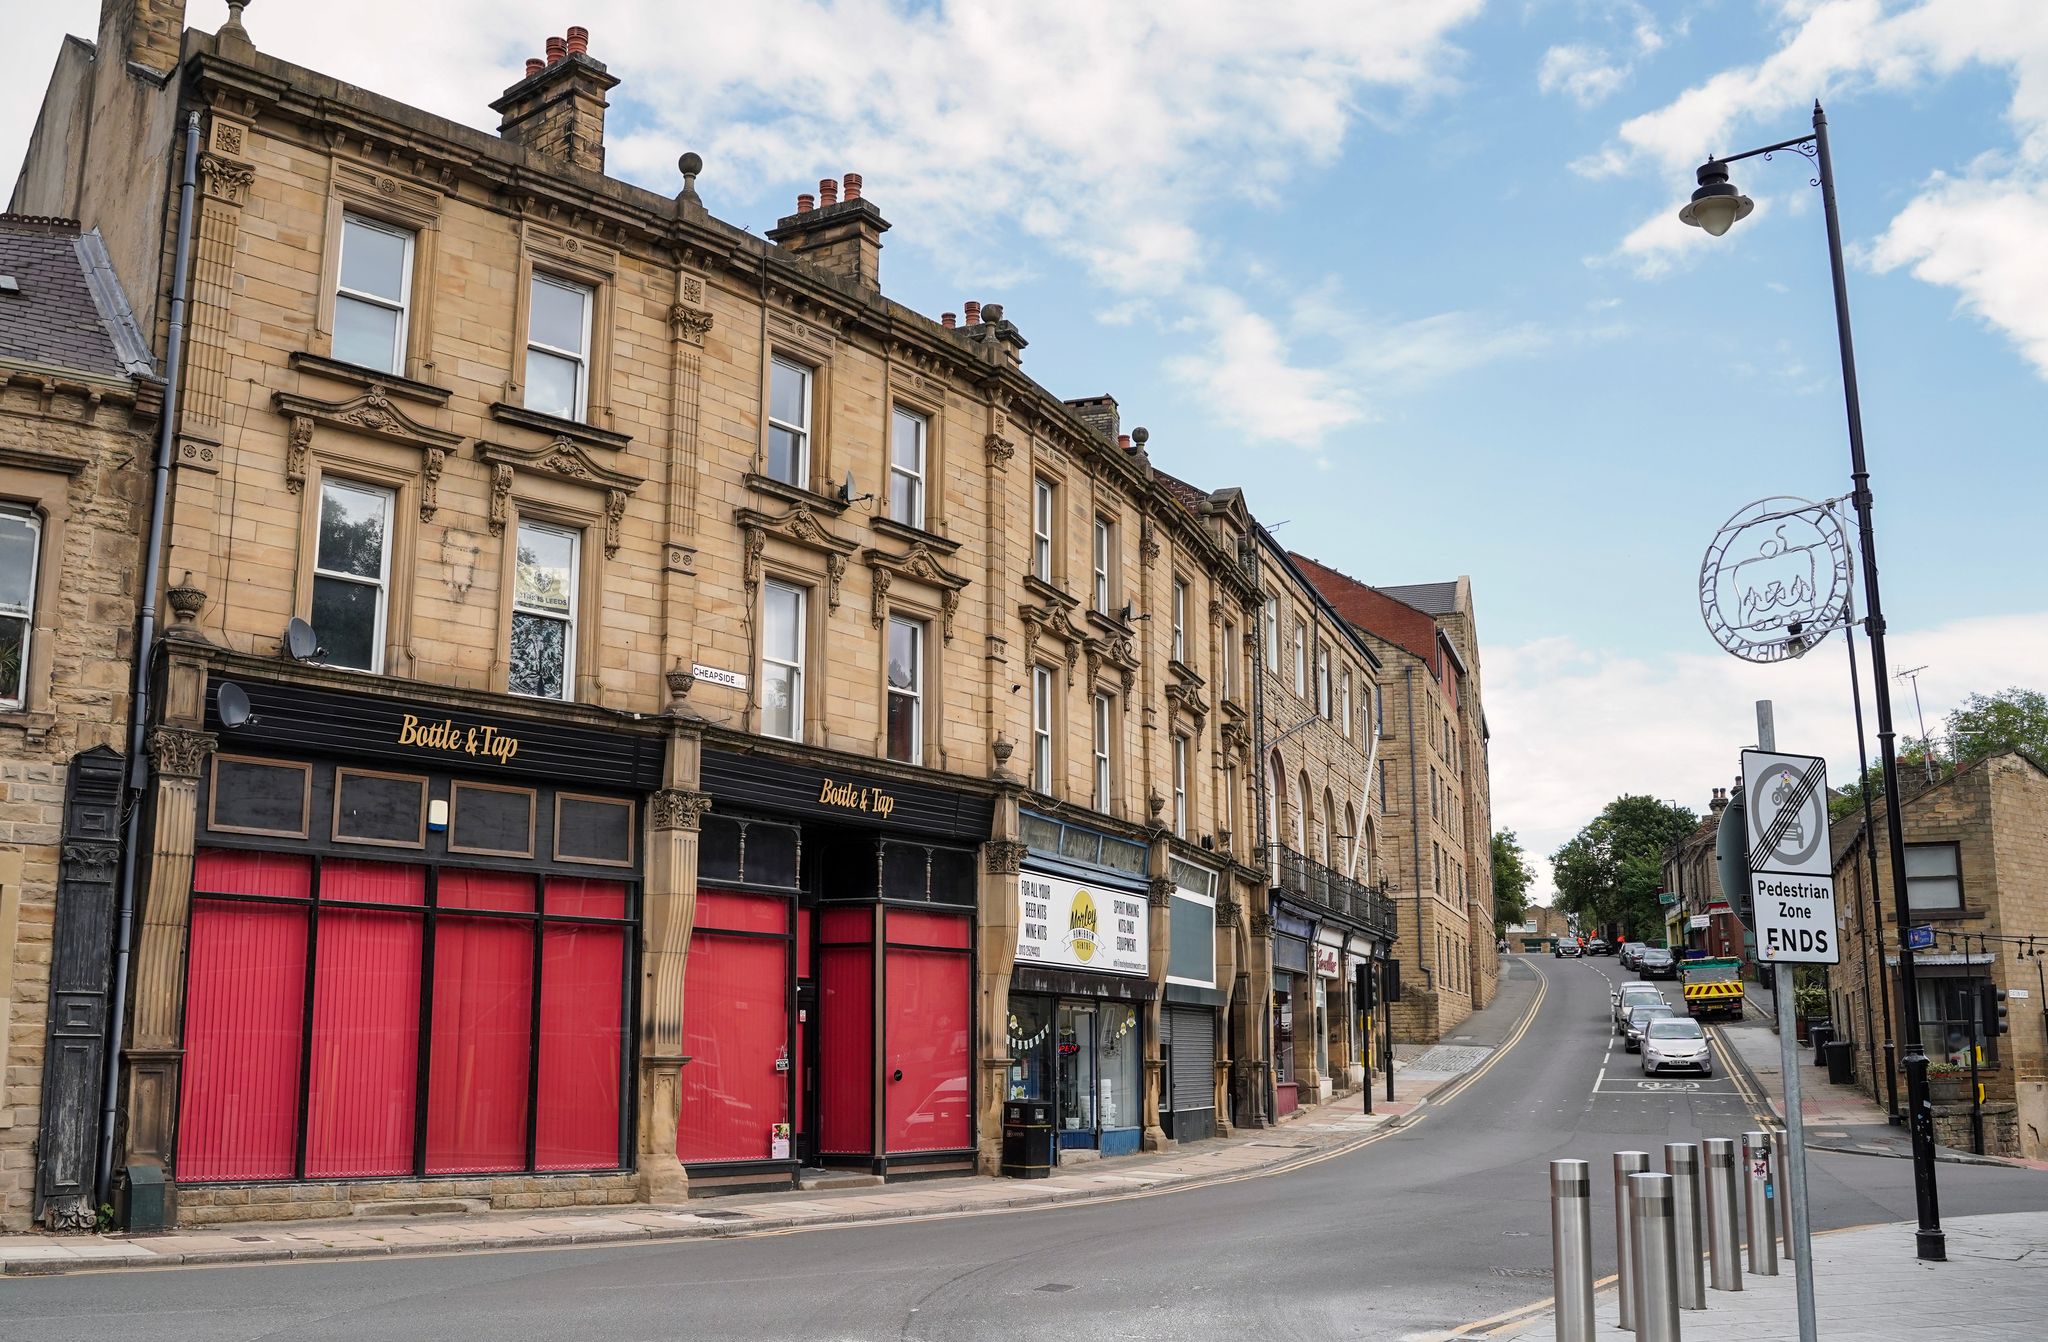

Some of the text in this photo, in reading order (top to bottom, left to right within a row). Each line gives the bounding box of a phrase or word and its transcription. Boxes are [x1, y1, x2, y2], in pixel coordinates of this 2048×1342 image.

[545, 598, 567, 606] LEEDS
[693, 667, 735, 684] CHEAPSIDE
[398, 714, 518, 764] Bottle & Tap
[819, 778, 894, 819] Bottle & Tap
[1021, 880, 1030, 896] FOR
[1038, 884, 1050, 900] YOUR
[1758, 880, 1829, 899] Pedestrian
[1025, 901, 1047, 920] BEER KITS
[1070, 904, 1097, 932] Morley
[1779, 902, 1811, 918] Zone
[1025, 923, 1047, 940] WINE KITS
[1767, 928, 1828, 953] ENDS
[1059, 1044, 1078, 1053] PEN
